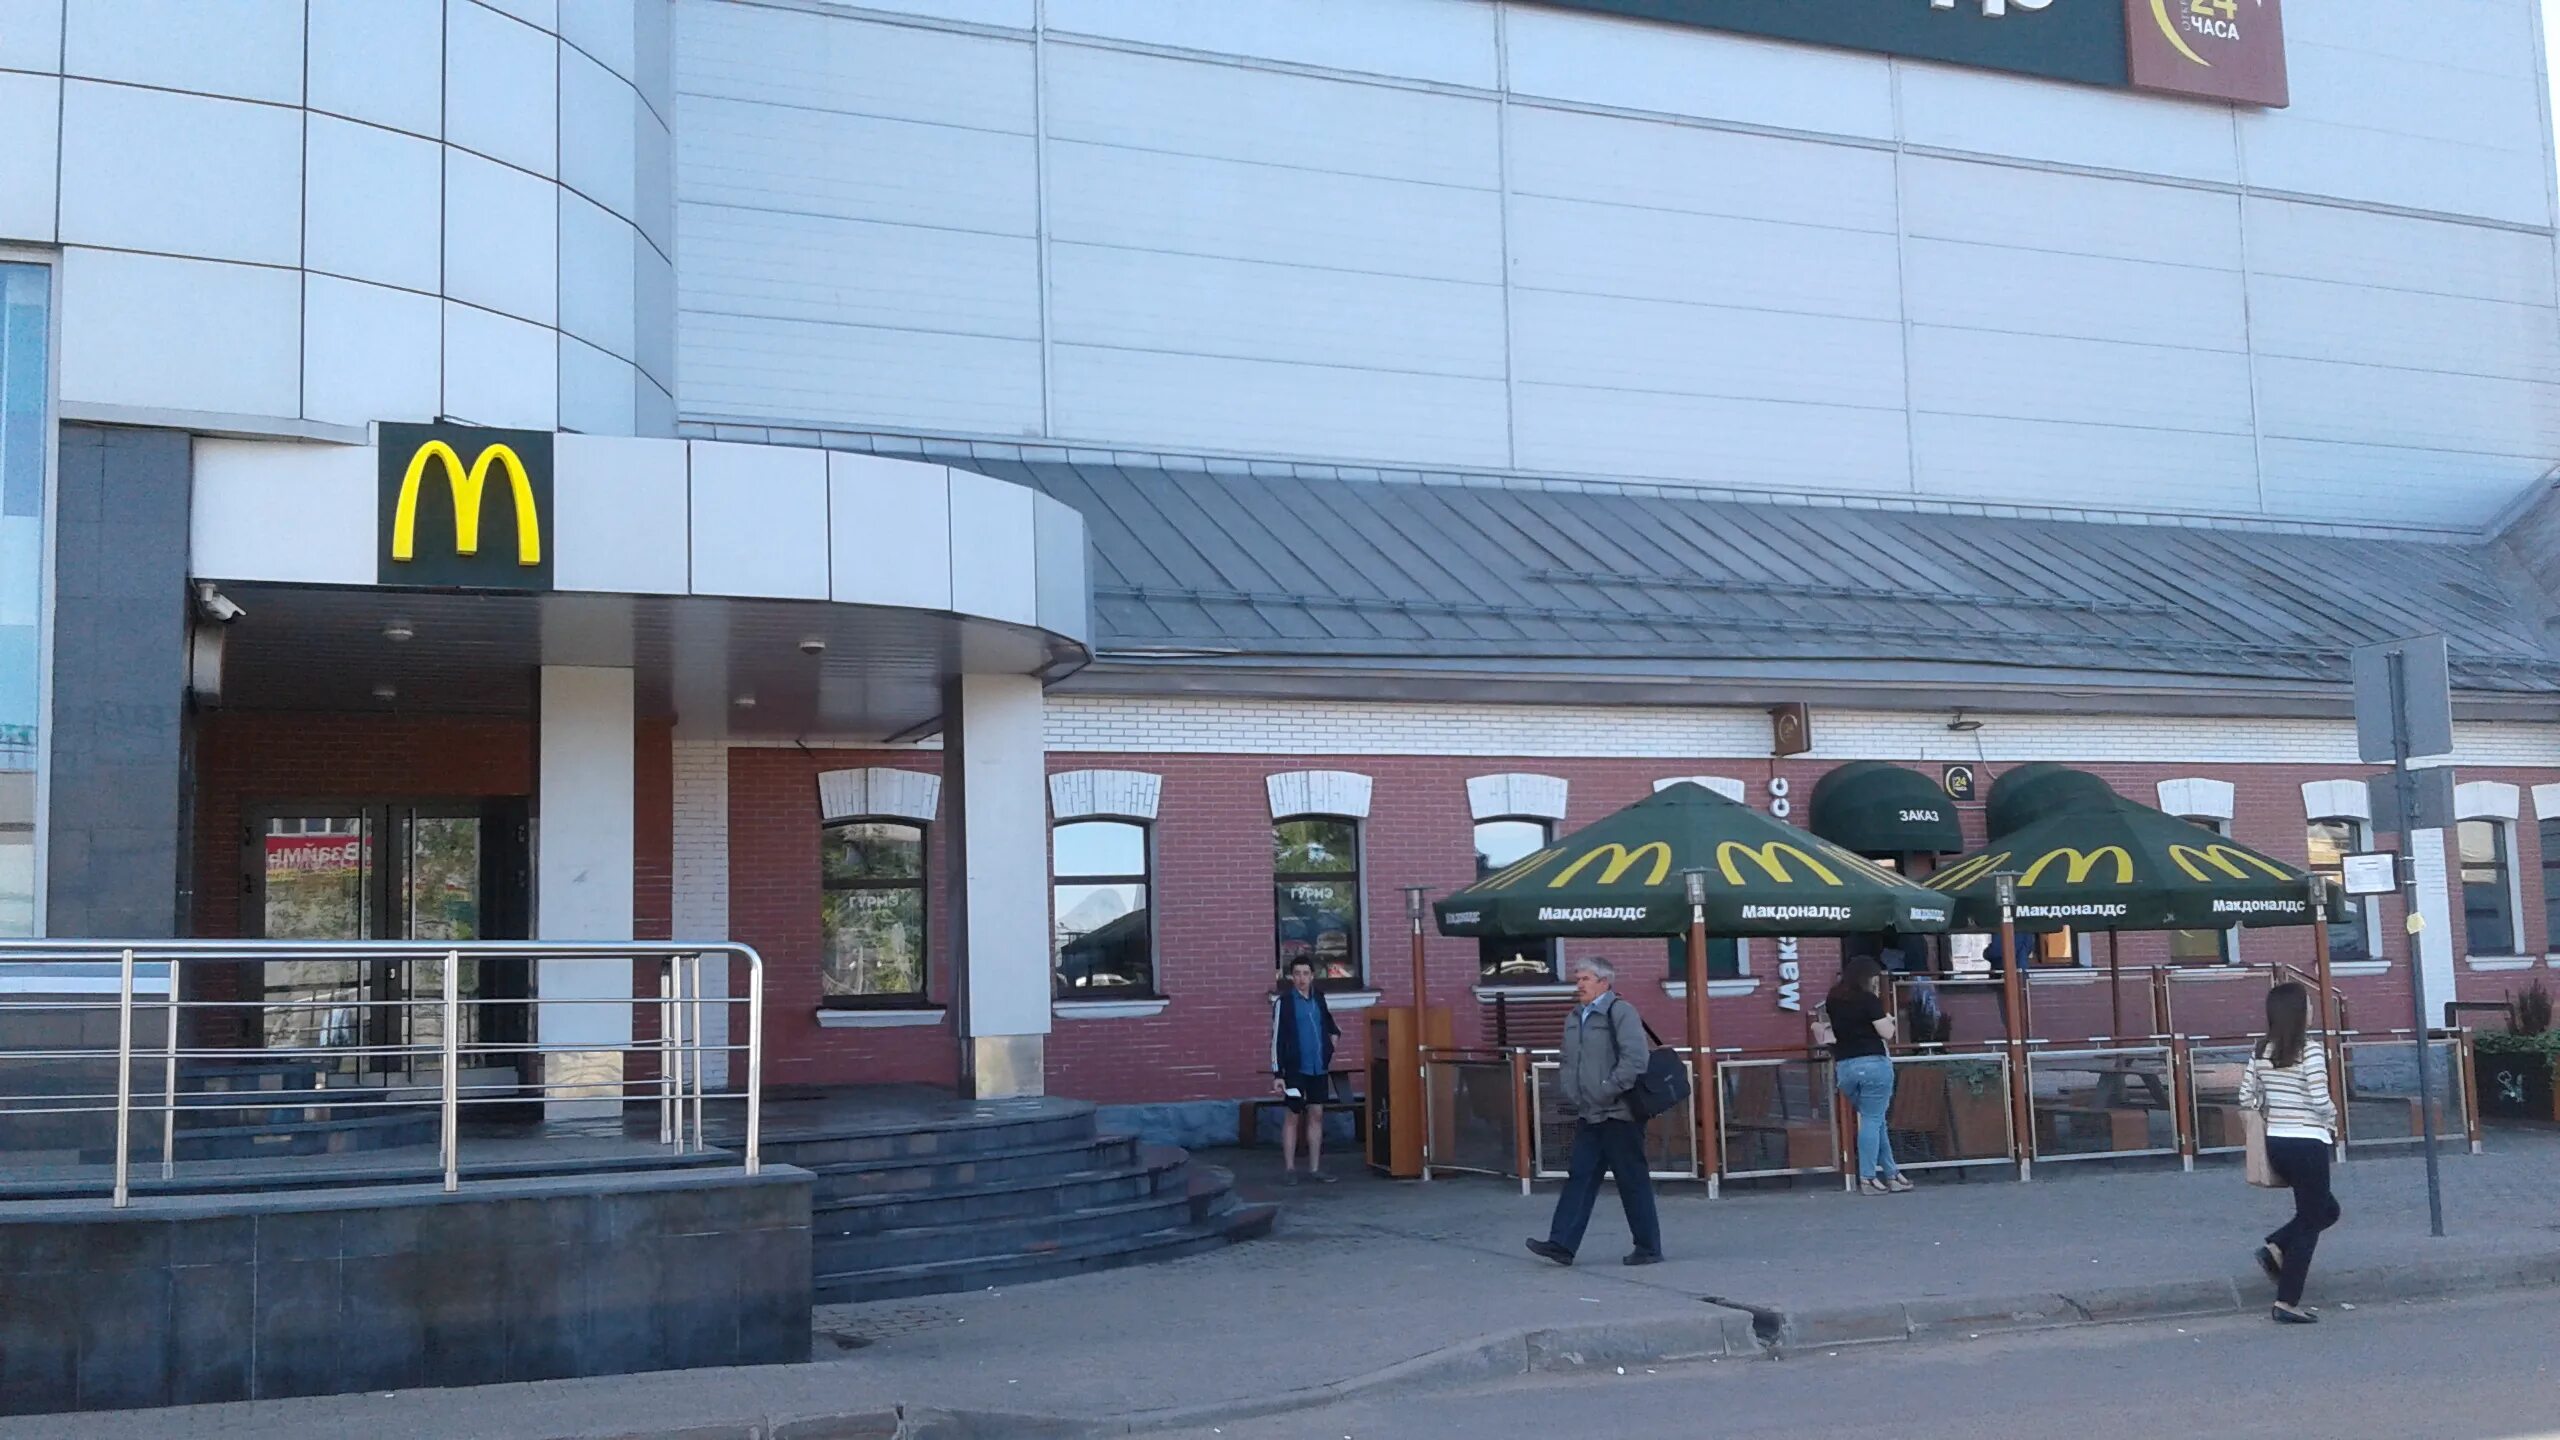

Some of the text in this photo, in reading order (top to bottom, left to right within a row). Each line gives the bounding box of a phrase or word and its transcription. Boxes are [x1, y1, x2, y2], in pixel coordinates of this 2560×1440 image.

[2190, 15, 2240, 40] ЧАСА
[1899, 809, 1939, 821] ЗАКАЗ
[1291, 887, 1334, 899] ГУРМЭ
[1742, 904, 1850, 920] Макдоналдс
[2016, 904, 2127, 918] Макдоналдс
[2213, 899, 2306, 913] Макдоналдс
[1538, 907, 1647, 921] Макдоналдс
